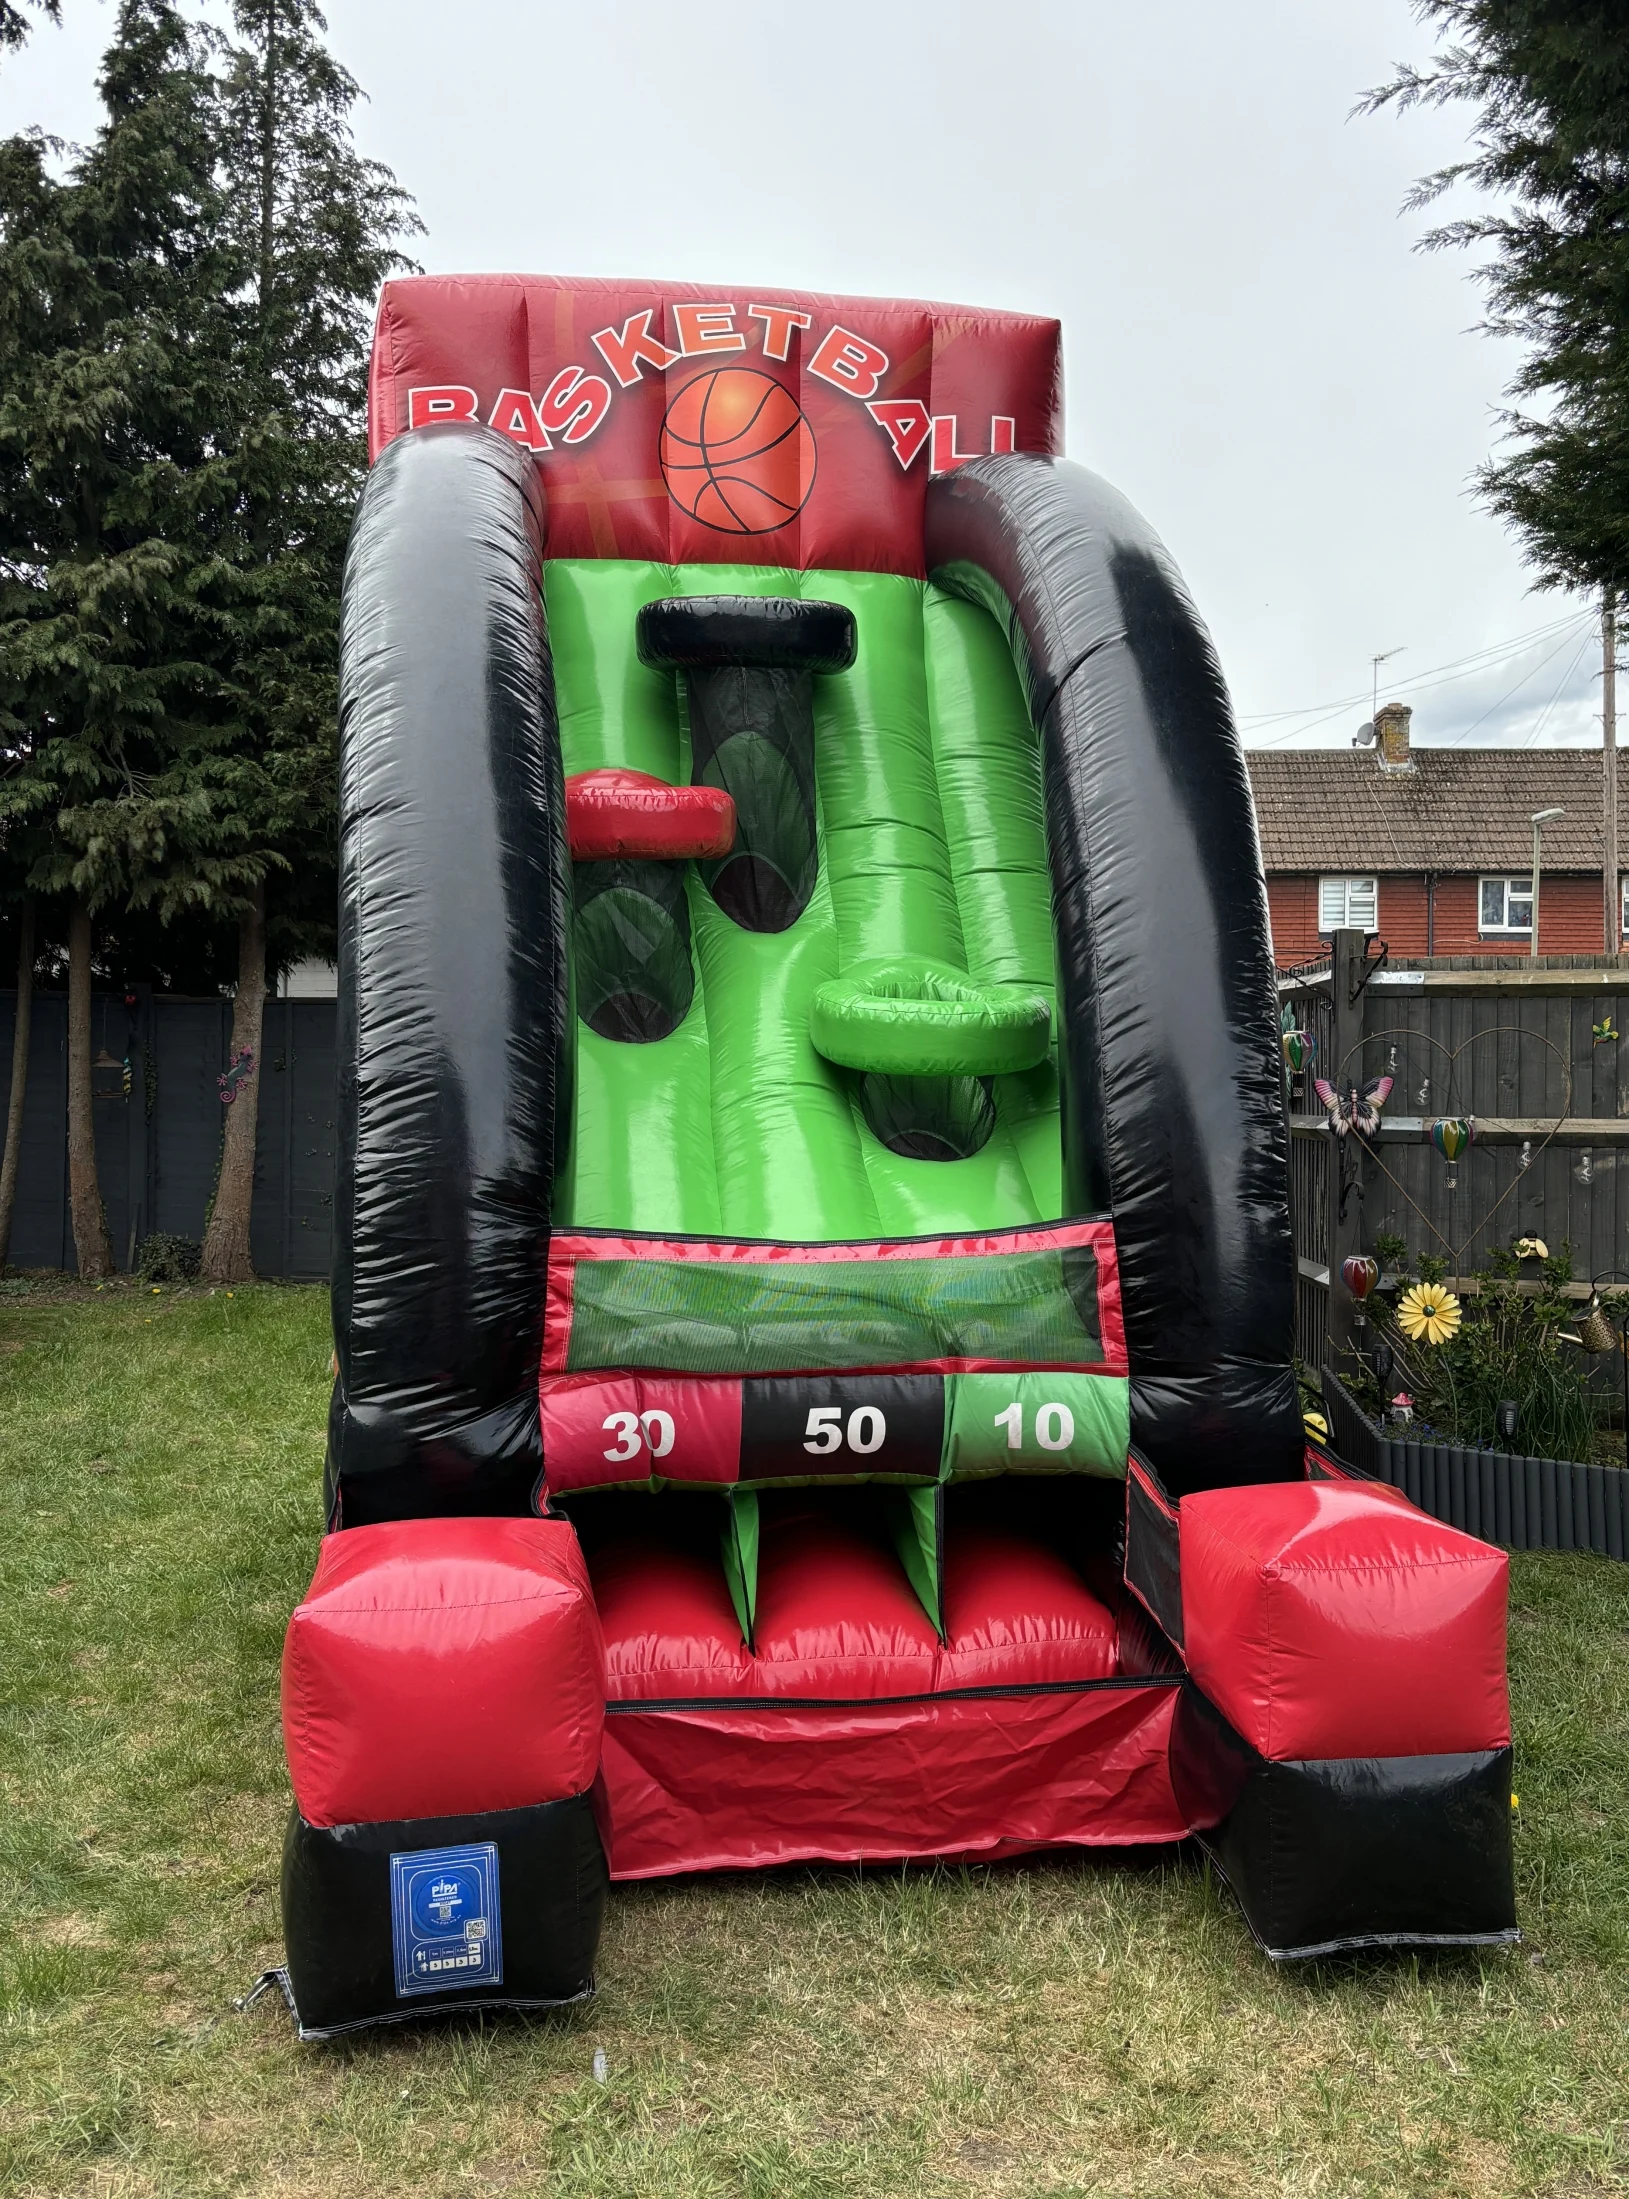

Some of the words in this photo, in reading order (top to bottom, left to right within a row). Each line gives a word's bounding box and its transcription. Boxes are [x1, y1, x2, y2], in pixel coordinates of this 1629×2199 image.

[601, 1410, 676, 1462] 30
[802, 1407, 886, 1454] 50
[993, 1402, 1075, 1450] 10
